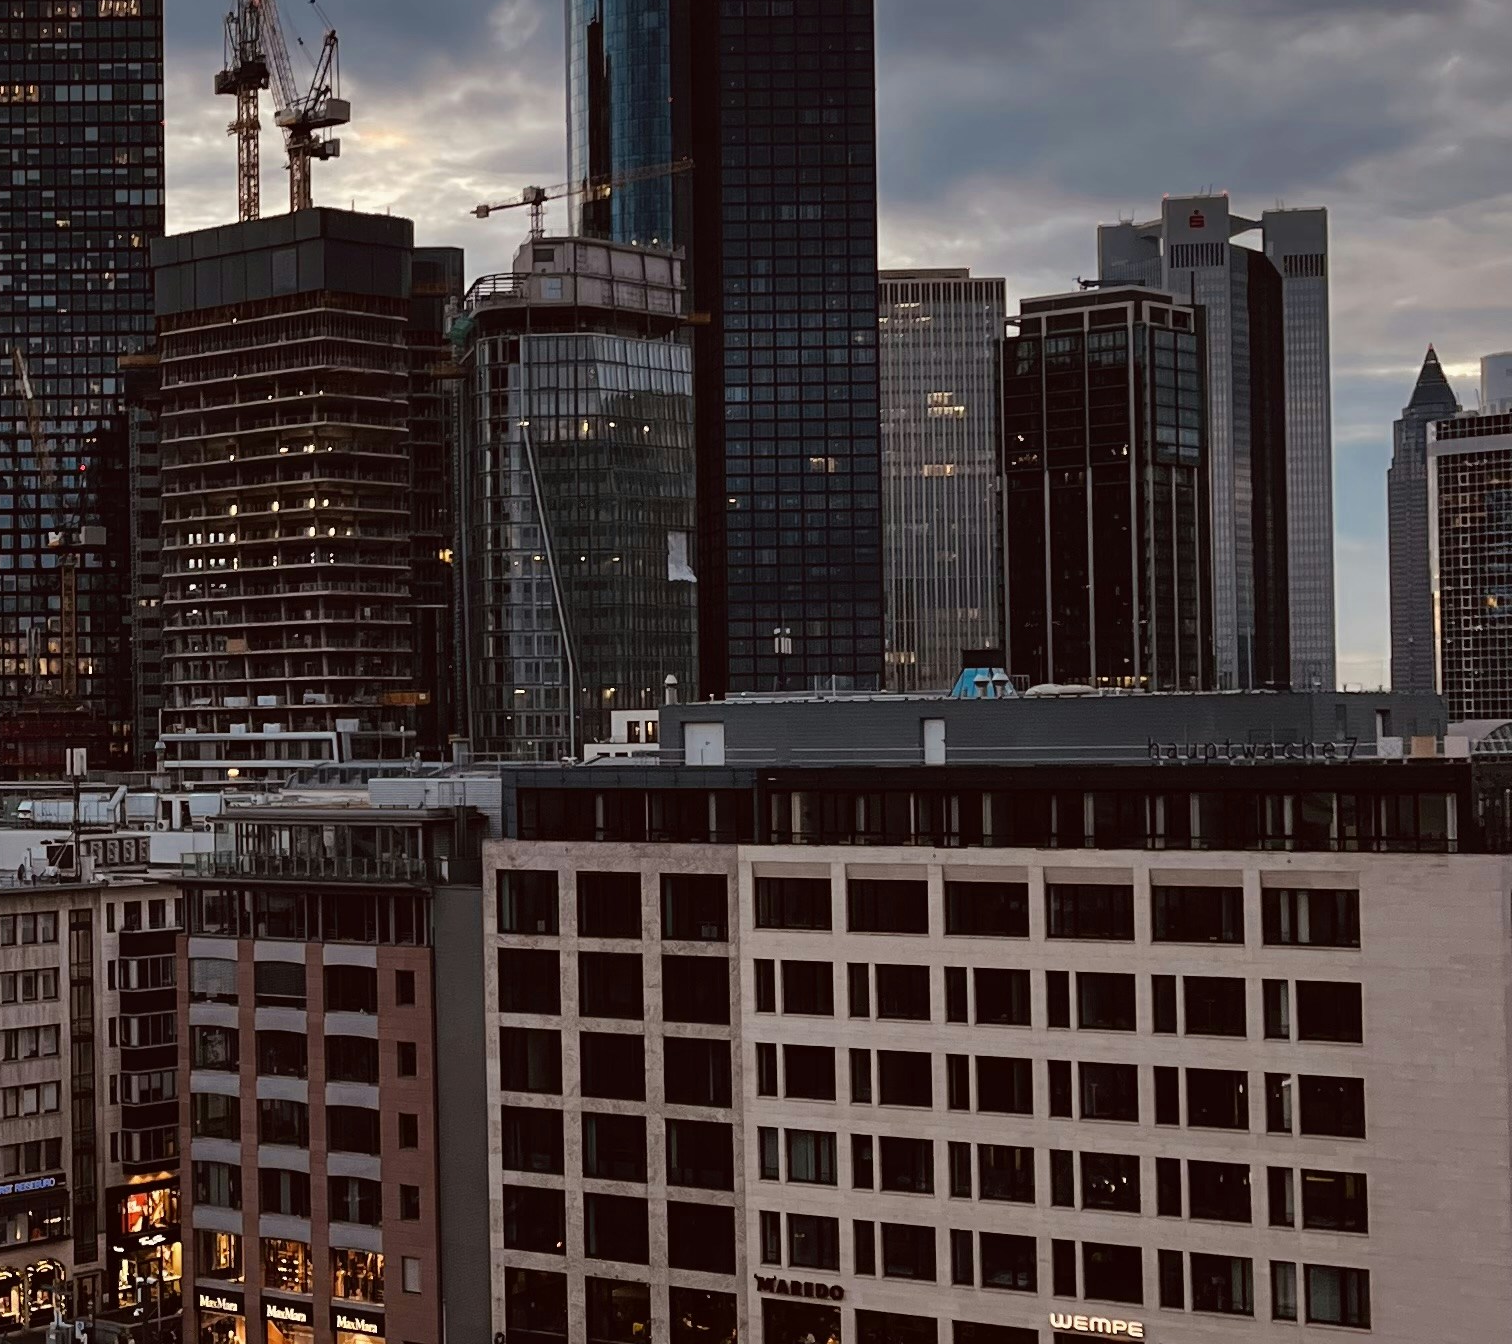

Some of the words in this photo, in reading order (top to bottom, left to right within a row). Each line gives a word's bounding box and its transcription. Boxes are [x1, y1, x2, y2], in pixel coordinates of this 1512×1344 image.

[266, 1304, 307, 1323] MaxMara
[336, 1315, 378, 1334] MaxMara
[1049, 1312, 1144, 1339] WEMPE
